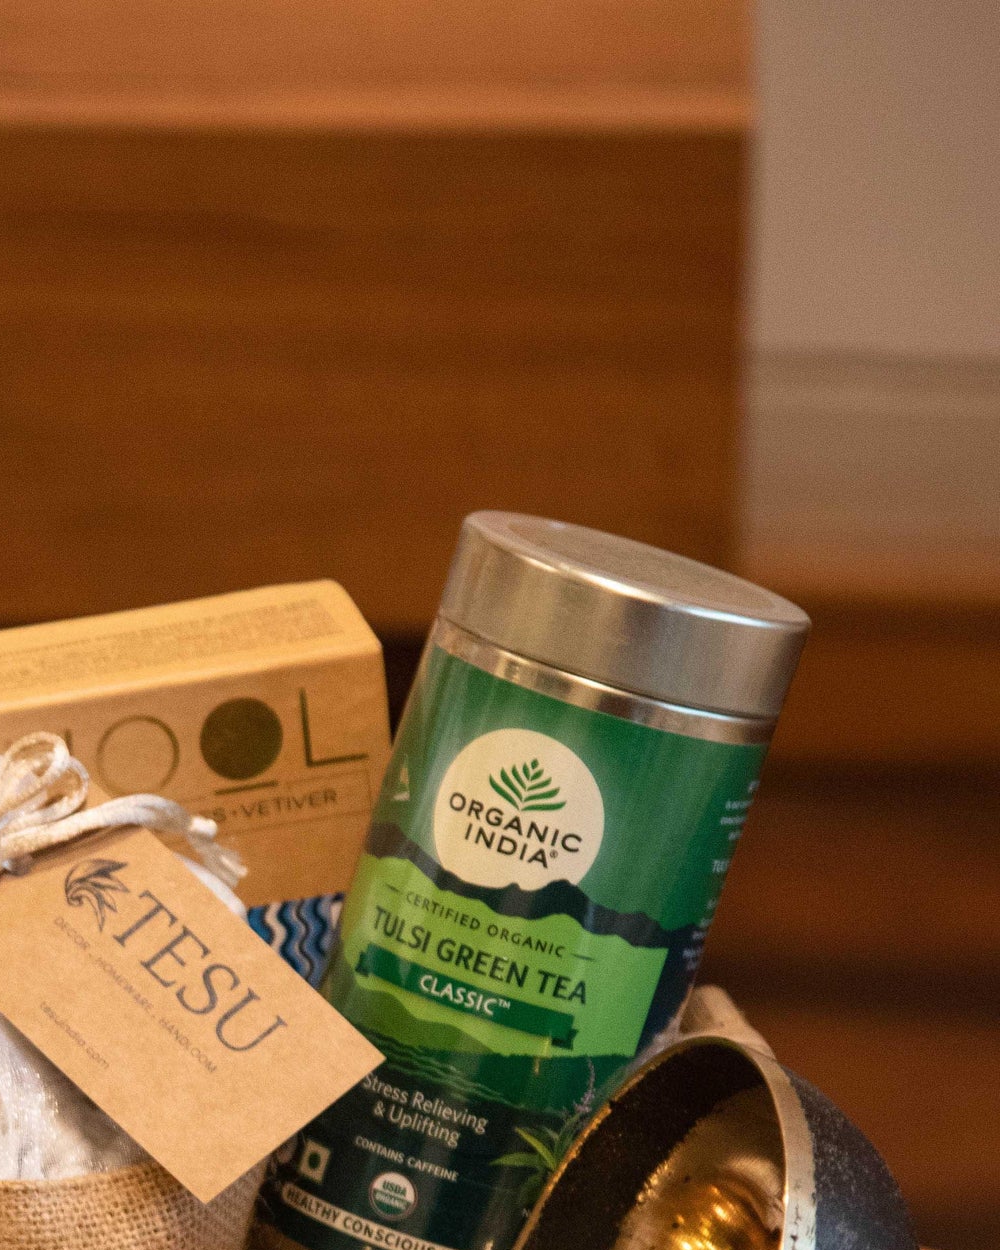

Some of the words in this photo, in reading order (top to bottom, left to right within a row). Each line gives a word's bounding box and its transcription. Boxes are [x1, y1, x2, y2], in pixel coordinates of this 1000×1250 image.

[449, 792, 582, 853] ORGANIC
[374, 905, 432, 953] TULSI
[436, 937, 530, 988] GREEN
[537, 969, 587, 1005] TEA
[405, 891, 481, 930] CERTIFIED
[487, 924, 566, 958] ORGANIC
[112, 889, 288, 1053] TESU
[362, 1071, 409, 1103] Stress
[412, 1091, 489, 1135] Relieving
[373, 1100, 385, 1117] &
[389, 1104, 461, 1149] Uplifting
[355, 1135, 405, 1163] CONTAINS
[407, 1156, 459, 1182] CAFFEINE
[286, 1185, 341, 1224] HEALTHY
